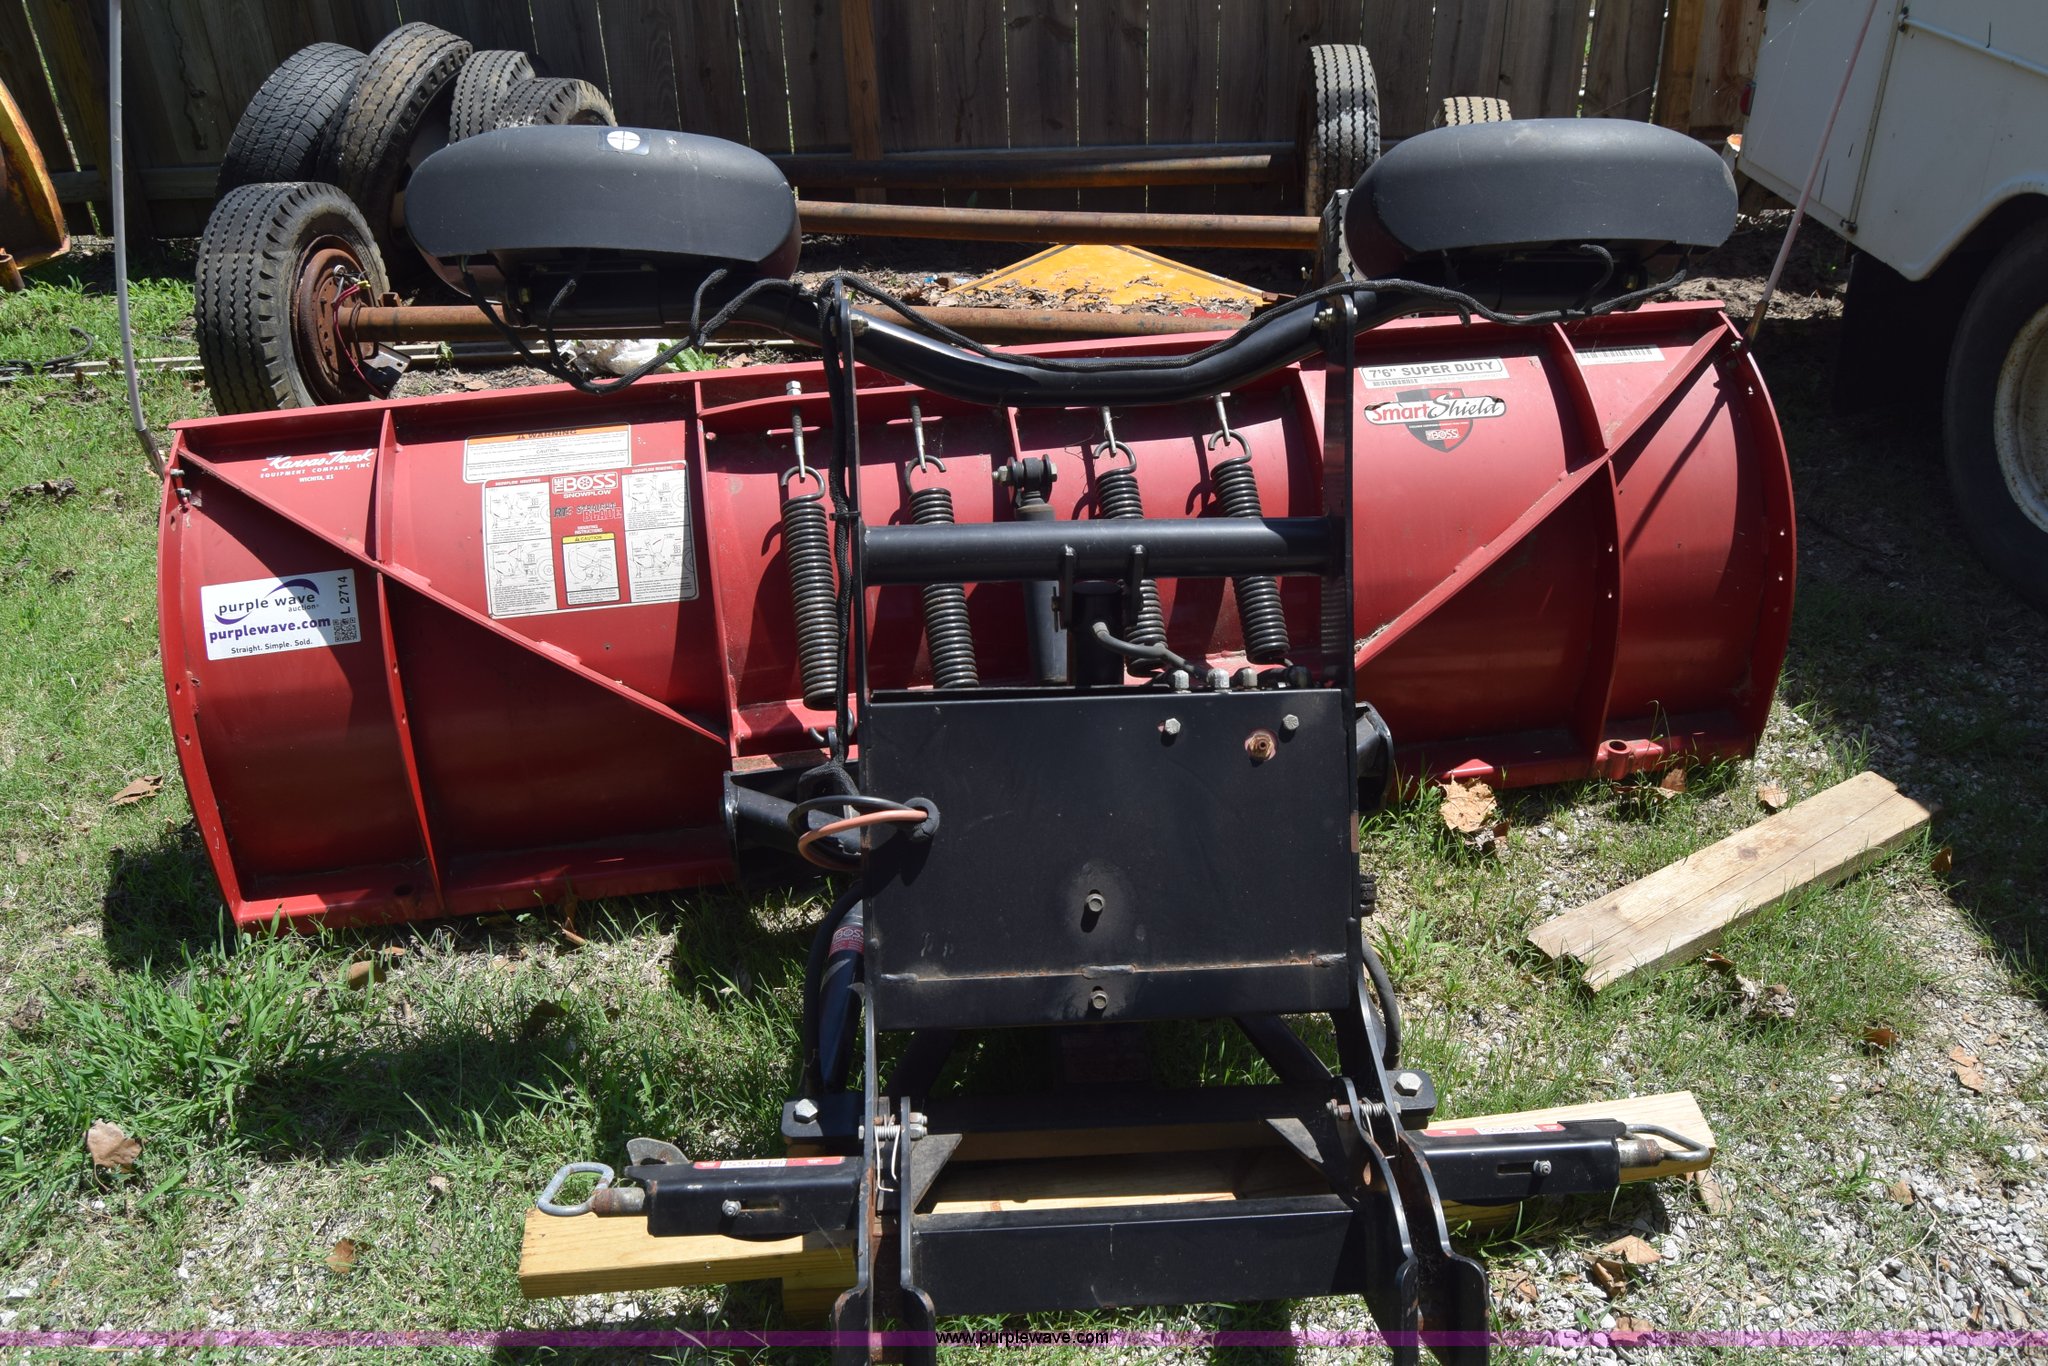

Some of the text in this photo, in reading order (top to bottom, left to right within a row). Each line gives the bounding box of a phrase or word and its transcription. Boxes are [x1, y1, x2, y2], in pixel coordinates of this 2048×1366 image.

[1402, 365, 1452, 377] SUPER
[1457, 360, 1496, 373] DUTY
[262, 448, 375, 472] Kansas Truck
[260, 469, 306, 479] EQUIPMENT
[554, 473, 617, 493] THE BOSS
[563, 489, 612, 499] SNOWPLOW
[337, 575, 350, 604] 2714
[219, 593, 316, 615] purple wave
[288, 603, 316, 612] auction
[209, 616, 331, 643] purplewave.com
[231, 638, 313, 654] Straight. Simple. Sold.
